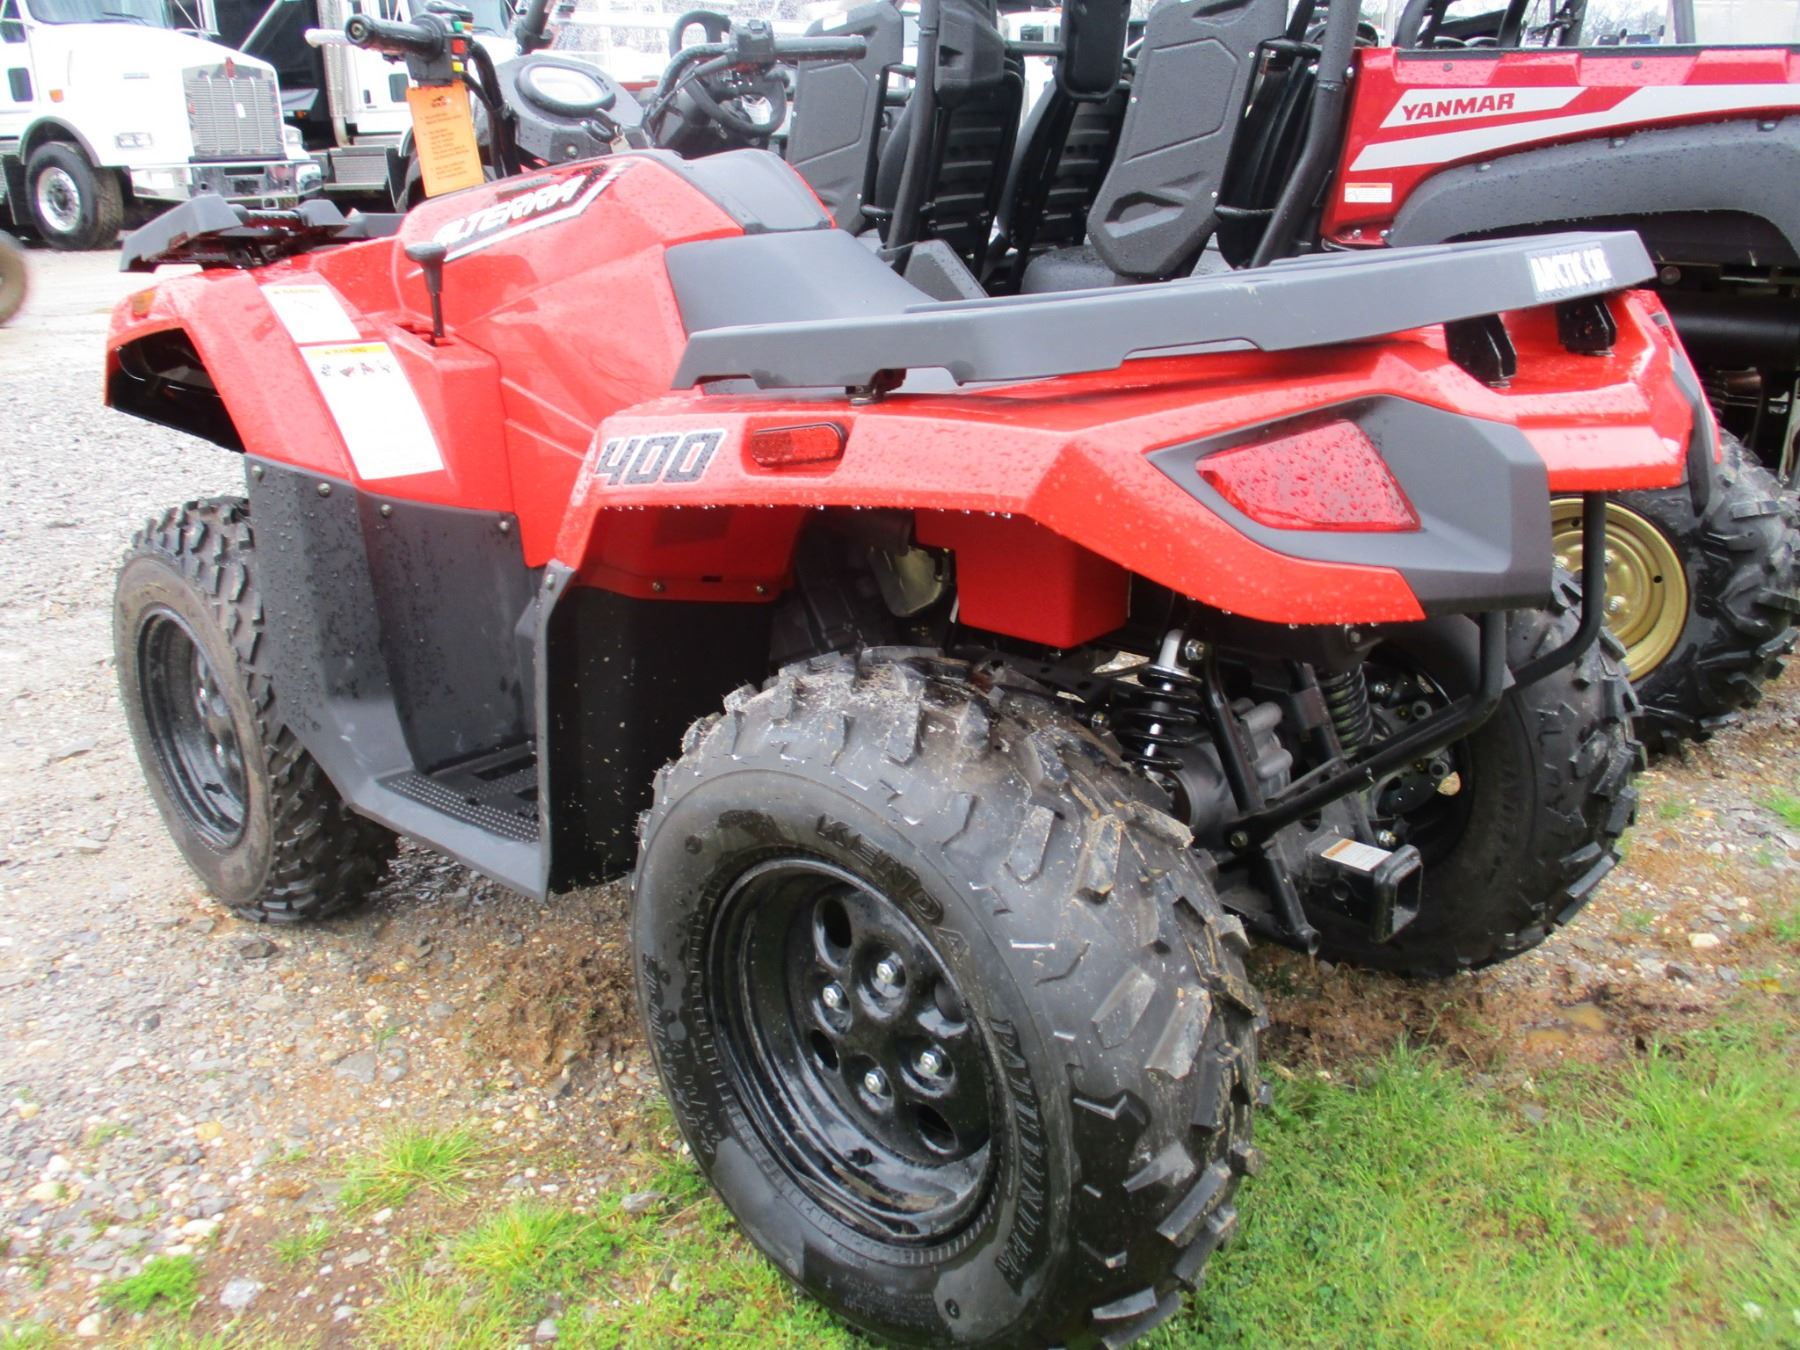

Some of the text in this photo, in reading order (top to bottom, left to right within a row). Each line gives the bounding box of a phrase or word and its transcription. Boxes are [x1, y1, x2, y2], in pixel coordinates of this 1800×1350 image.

[1402, 92, 1516, 121] YANMAR
[432, 174, 588, 246] ALTERRA
[1530, 251, 1590, 292] ARCTIC
[595, 429, 725, 486] 400
[816, 813, 970, 962] KENDA
